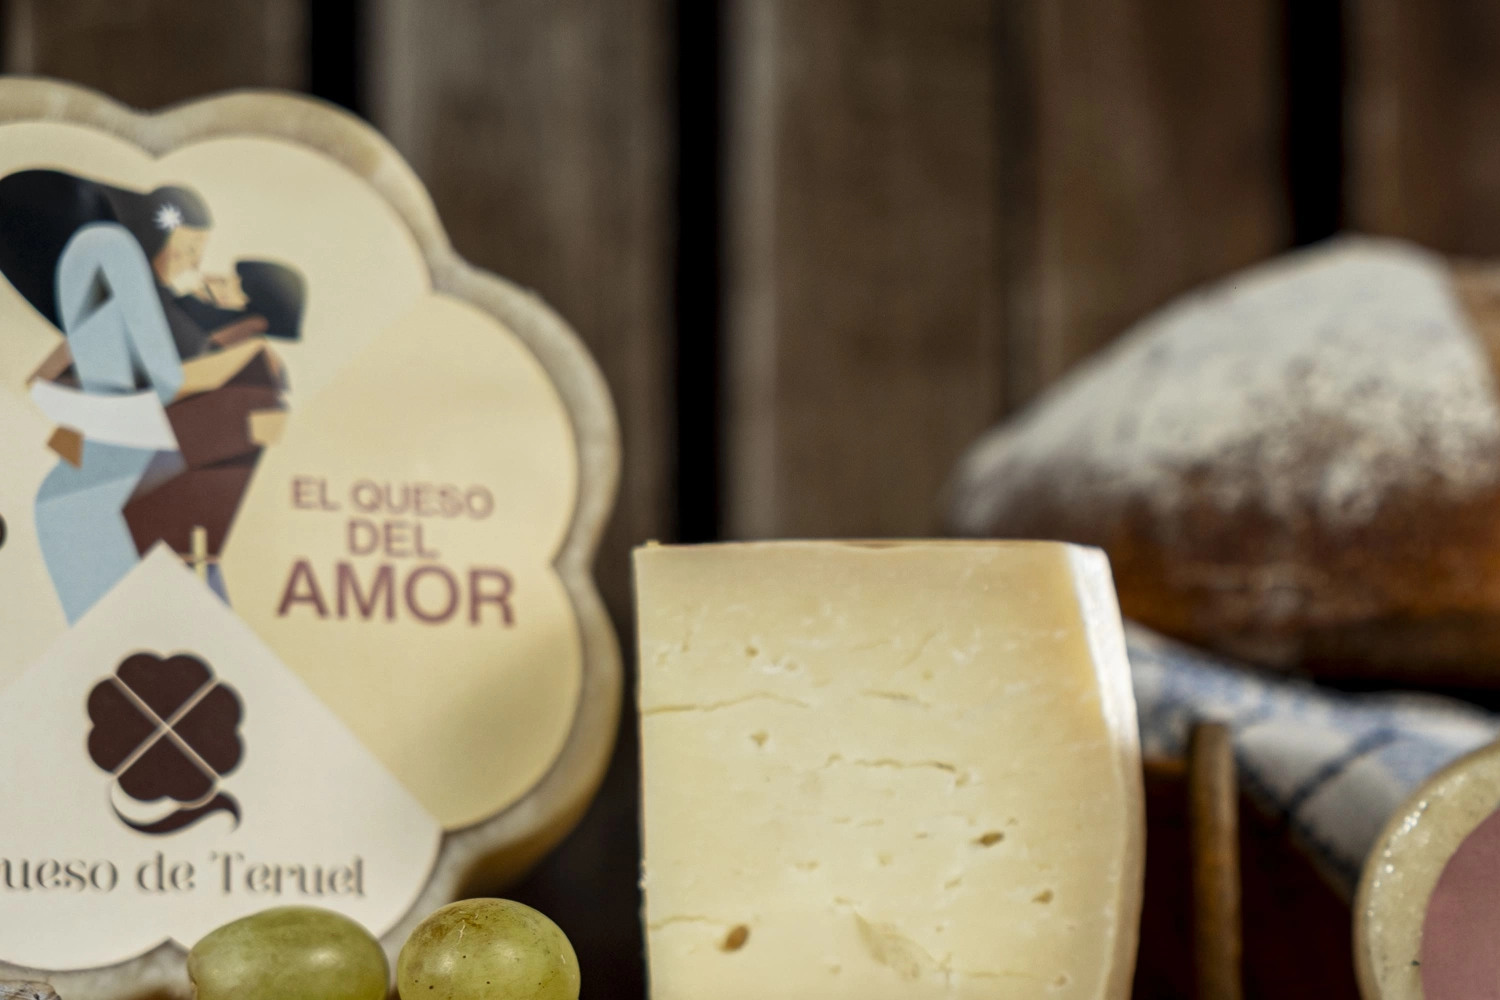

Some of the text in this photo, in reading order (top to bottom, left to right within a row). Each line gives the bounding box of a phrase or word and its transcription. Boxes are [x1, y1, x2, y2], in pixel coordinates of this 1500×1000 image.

[290, 476, 495, 520] EL QUESO
[346, 518, 441, 560] DEL
[275, 559, 516, 627] AMOR
[0, 851, 366, 897] ueso de Teruel
